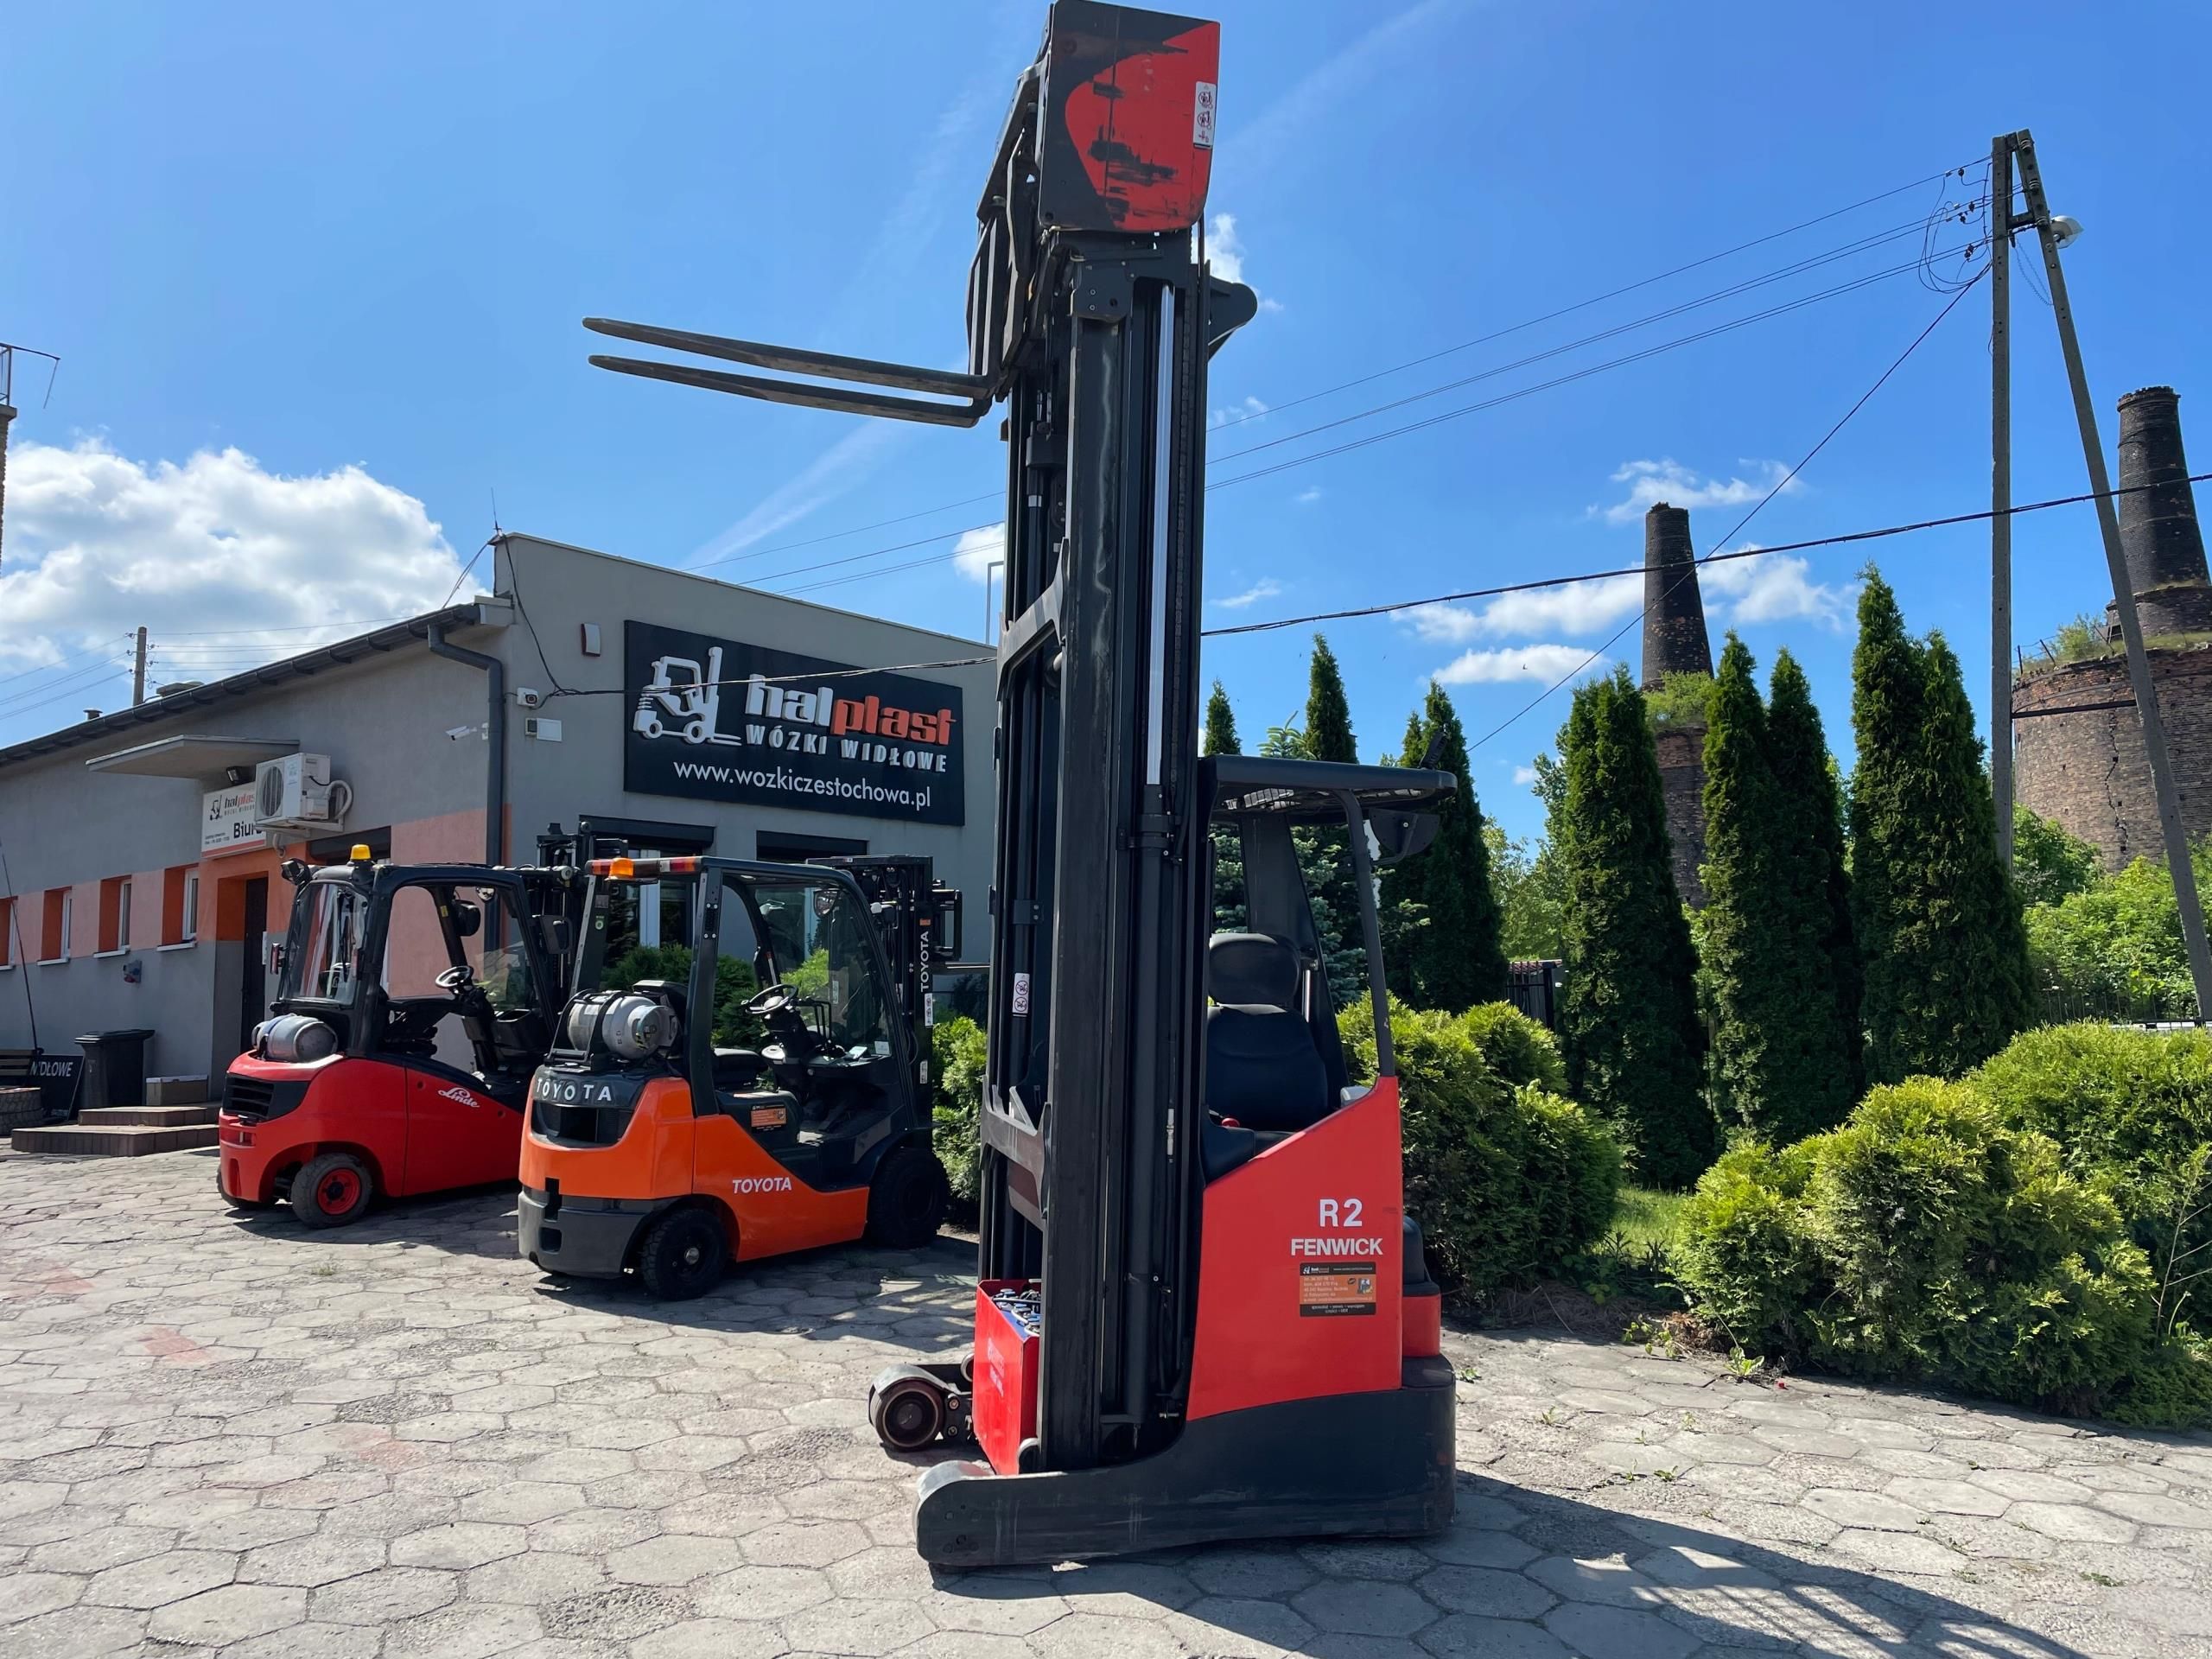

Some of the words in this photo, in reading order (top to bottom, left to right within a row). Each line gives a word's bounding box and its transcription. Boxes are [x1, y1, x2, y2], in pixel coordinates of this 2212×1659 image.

[745, 673, 957, 746] halplast
[746, 724, 827, 755] WÓZKI
[841, 739, 947, 772] WIDŁOWE
[673, 761, 931, 810] www.wozkiczestochowa.pl
[225, 793, 255, 809] halplas
[920, 931, 929, 992] TOYOTA
[29, 1061, 73, 1077] WDŁOWE
[438, 1087, 480, 1108] Linde
[535, 1077, 612, 1102] TOYOTA
[732, 1177, 792, 1194] TOYOTA
[1291, 1238, 1383, 1256] FENWICK
